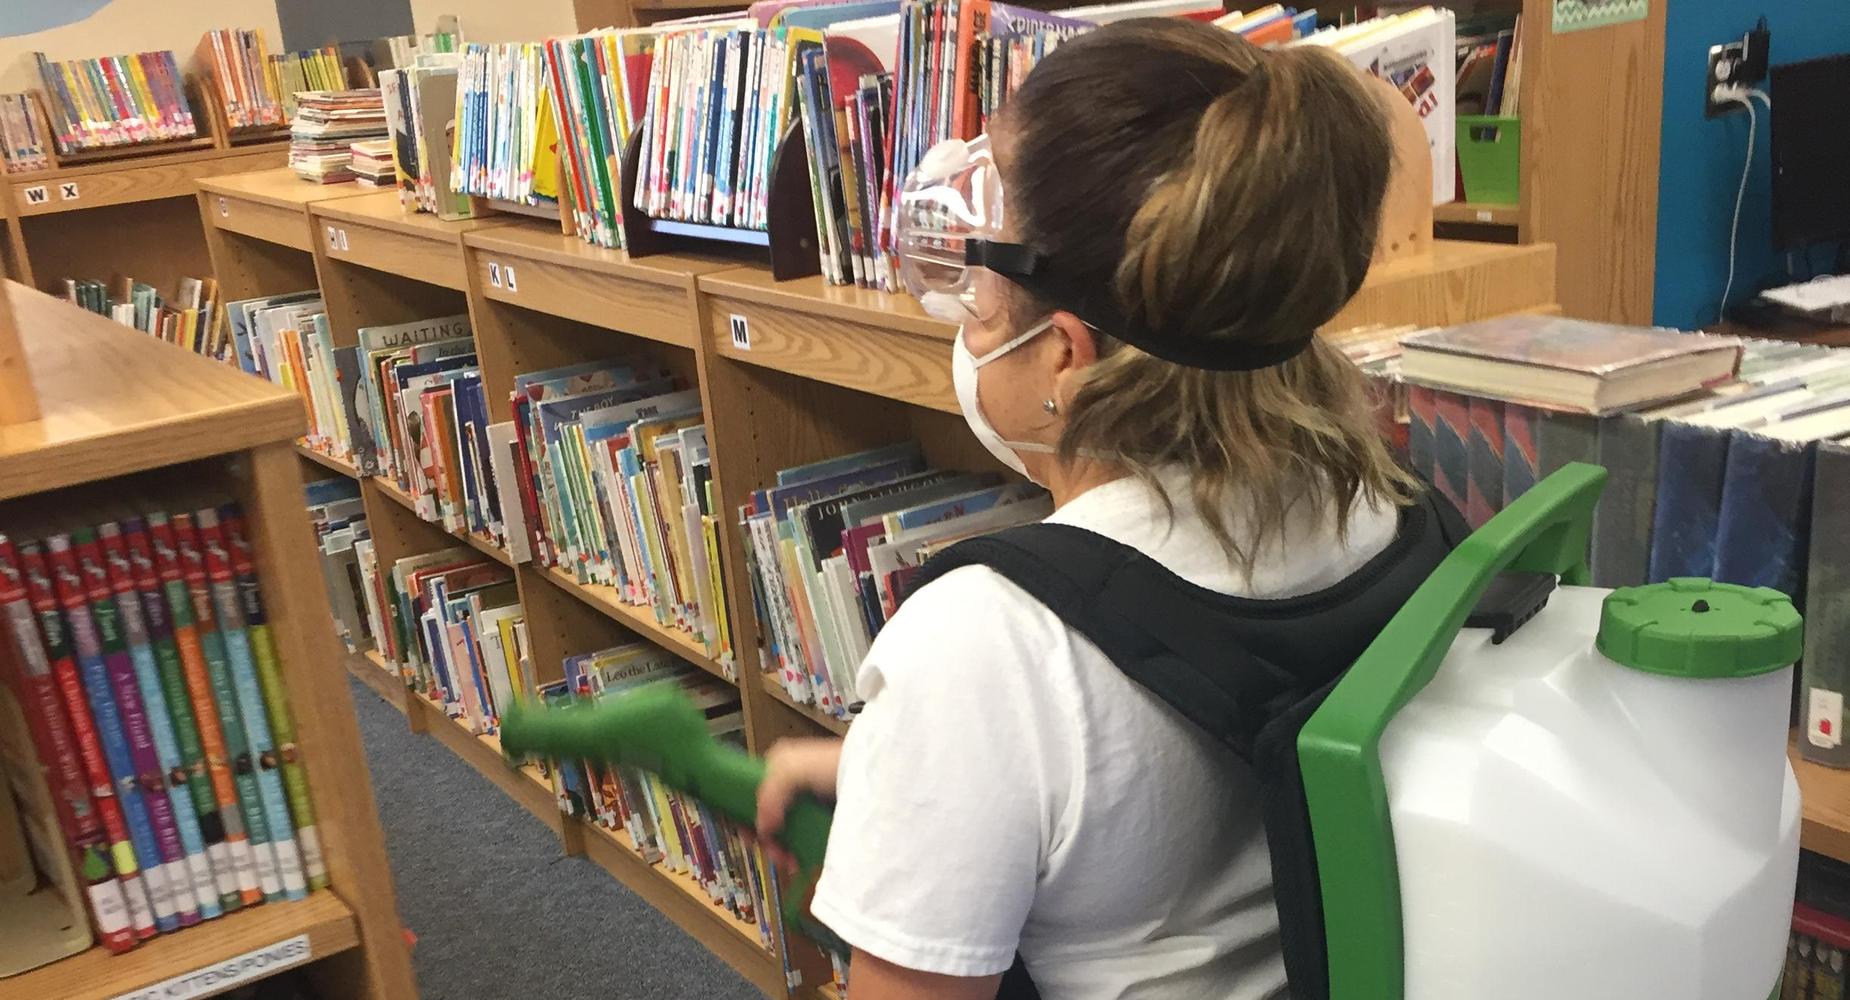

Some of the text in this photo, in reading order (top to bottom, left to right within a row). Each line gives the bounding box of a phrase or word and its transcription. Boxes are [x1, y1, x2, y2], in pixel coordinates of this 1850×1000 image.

[28, 185, 76, 202] W X
[490, 265, 513, 288] K L
[382, 323, 463, 346] WAITING
[733, 319, 747, 343] M
[605, 671, 627, 683] Leo
